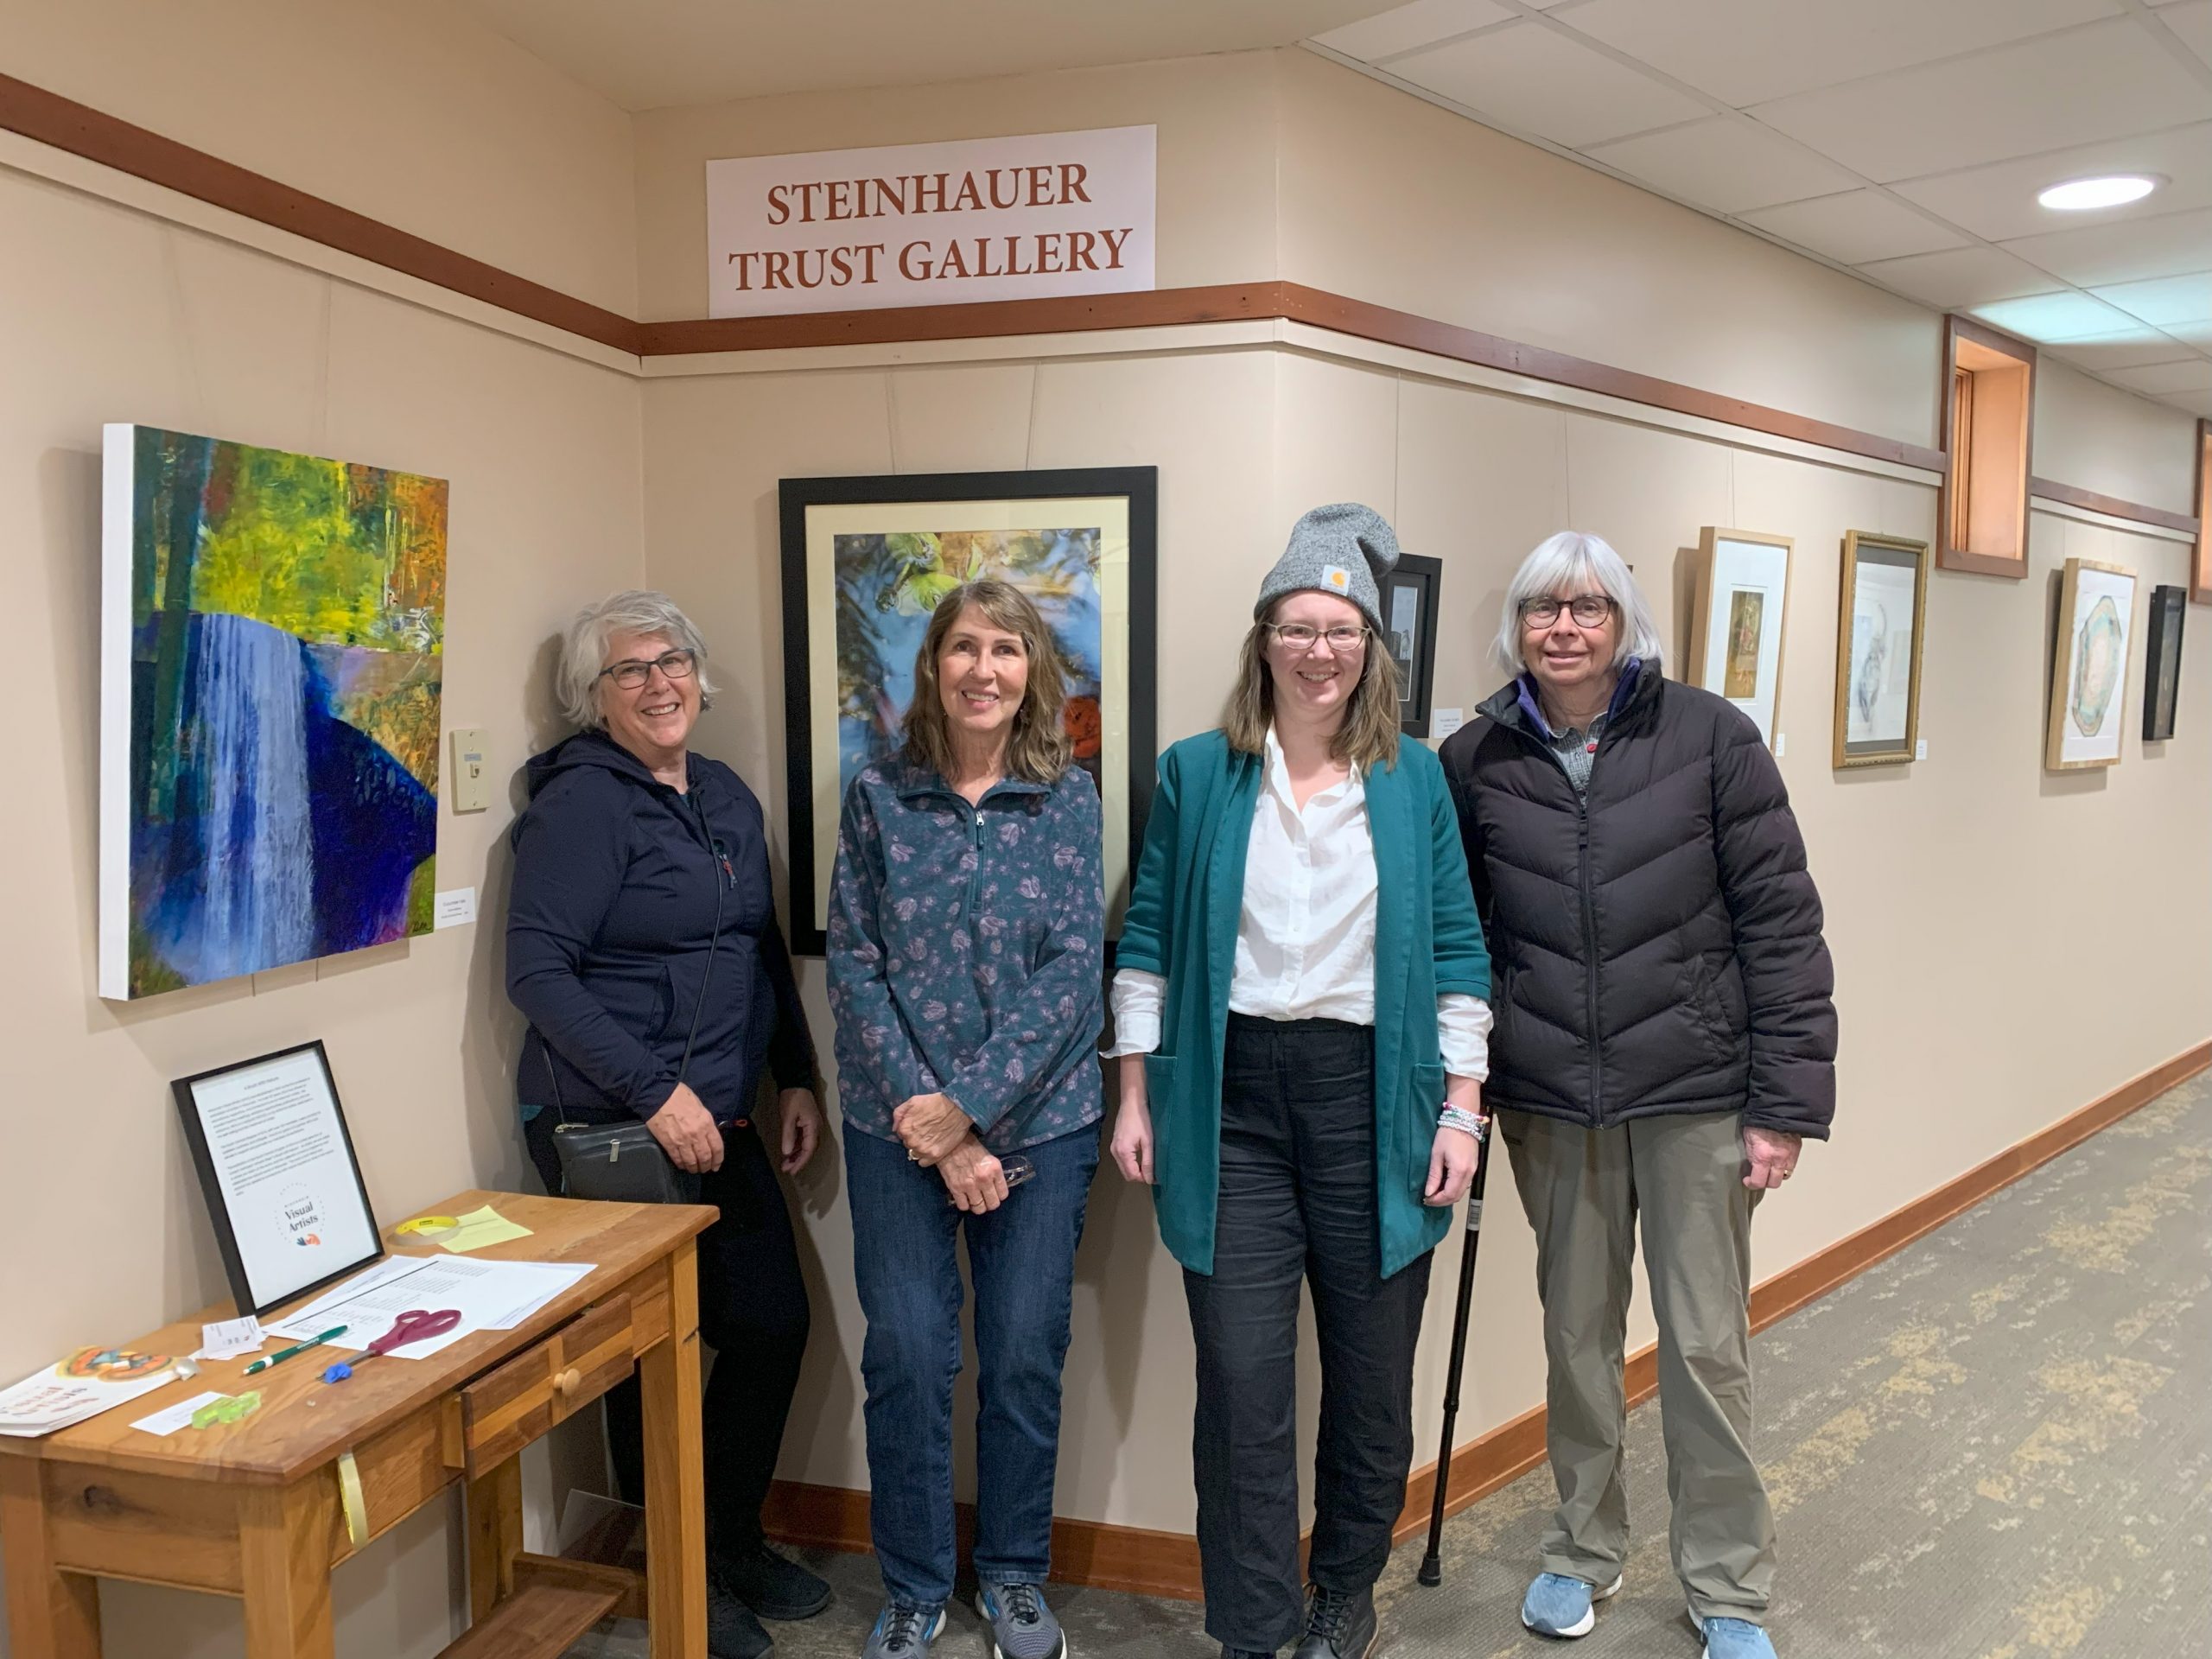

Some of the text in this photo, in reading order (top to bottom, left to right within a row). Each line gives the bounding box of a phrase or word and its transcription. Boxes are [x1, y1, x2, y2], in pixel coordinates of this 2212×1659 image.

[767, 162, 1092, 225] STEINHAUER
[728, 228, 1134, 290] TRUST GALLERY
[284, 1201, 314, 1220] Visual
[289, 1215, 319, 1232] Artists
